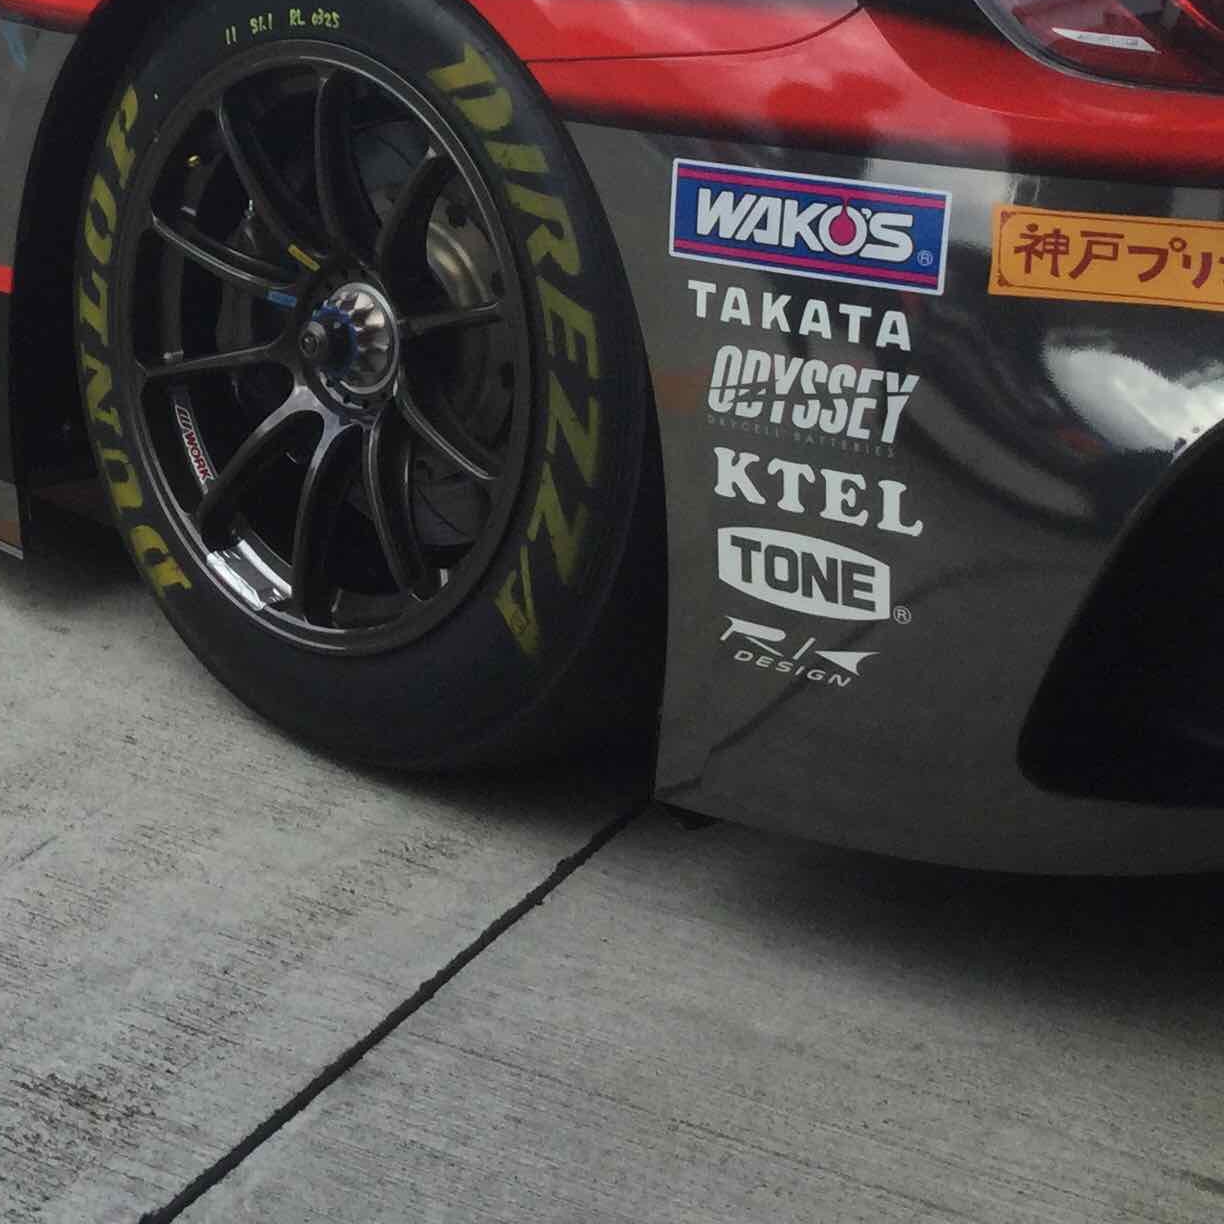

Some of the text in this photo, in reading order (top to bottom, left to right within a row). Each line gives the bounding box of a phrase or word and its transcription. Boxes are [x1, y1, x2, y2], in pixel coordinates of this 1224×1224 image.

[1014, 223, 1224, 289] 神戸プリ
[78, 81, 192, 598] DUNLOP
[688, 279, 911, 352] TAKATA
[707, 344, 920, 444] ODYSSEY
[713, 446, 924, 537] KTEL
[730, 534, 876, 612] TONE
[733, 649, 852, 688] DESIGN
